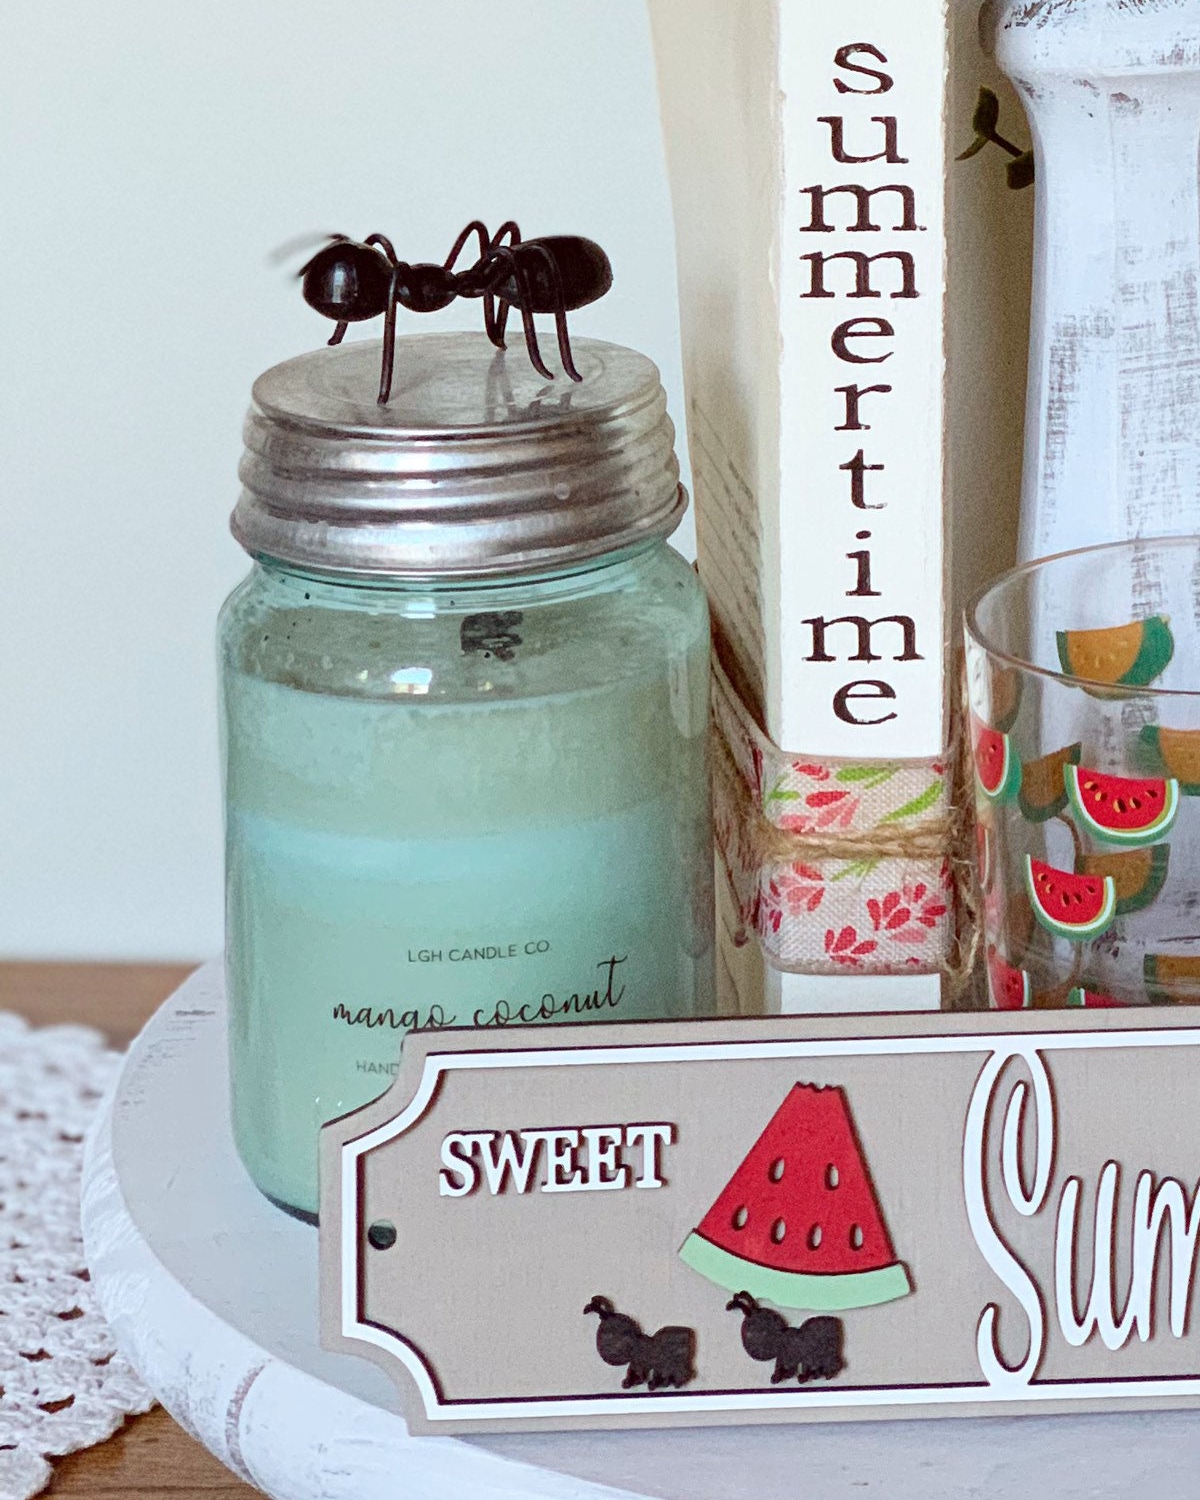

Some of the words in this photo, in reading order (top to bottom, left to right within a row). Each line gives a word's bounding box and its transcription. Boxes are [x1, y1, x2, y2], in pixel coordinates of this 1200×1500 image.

[798, 41, 928, 727] summertime
[408, 949, 443, 963] LGH
[448, 944, 518, 962] CANDLE
[333, 1003, 457, 1030] mango
[473, 955, 628, 1026] coconut
[438, 1123, 677, 1198] SWEET
